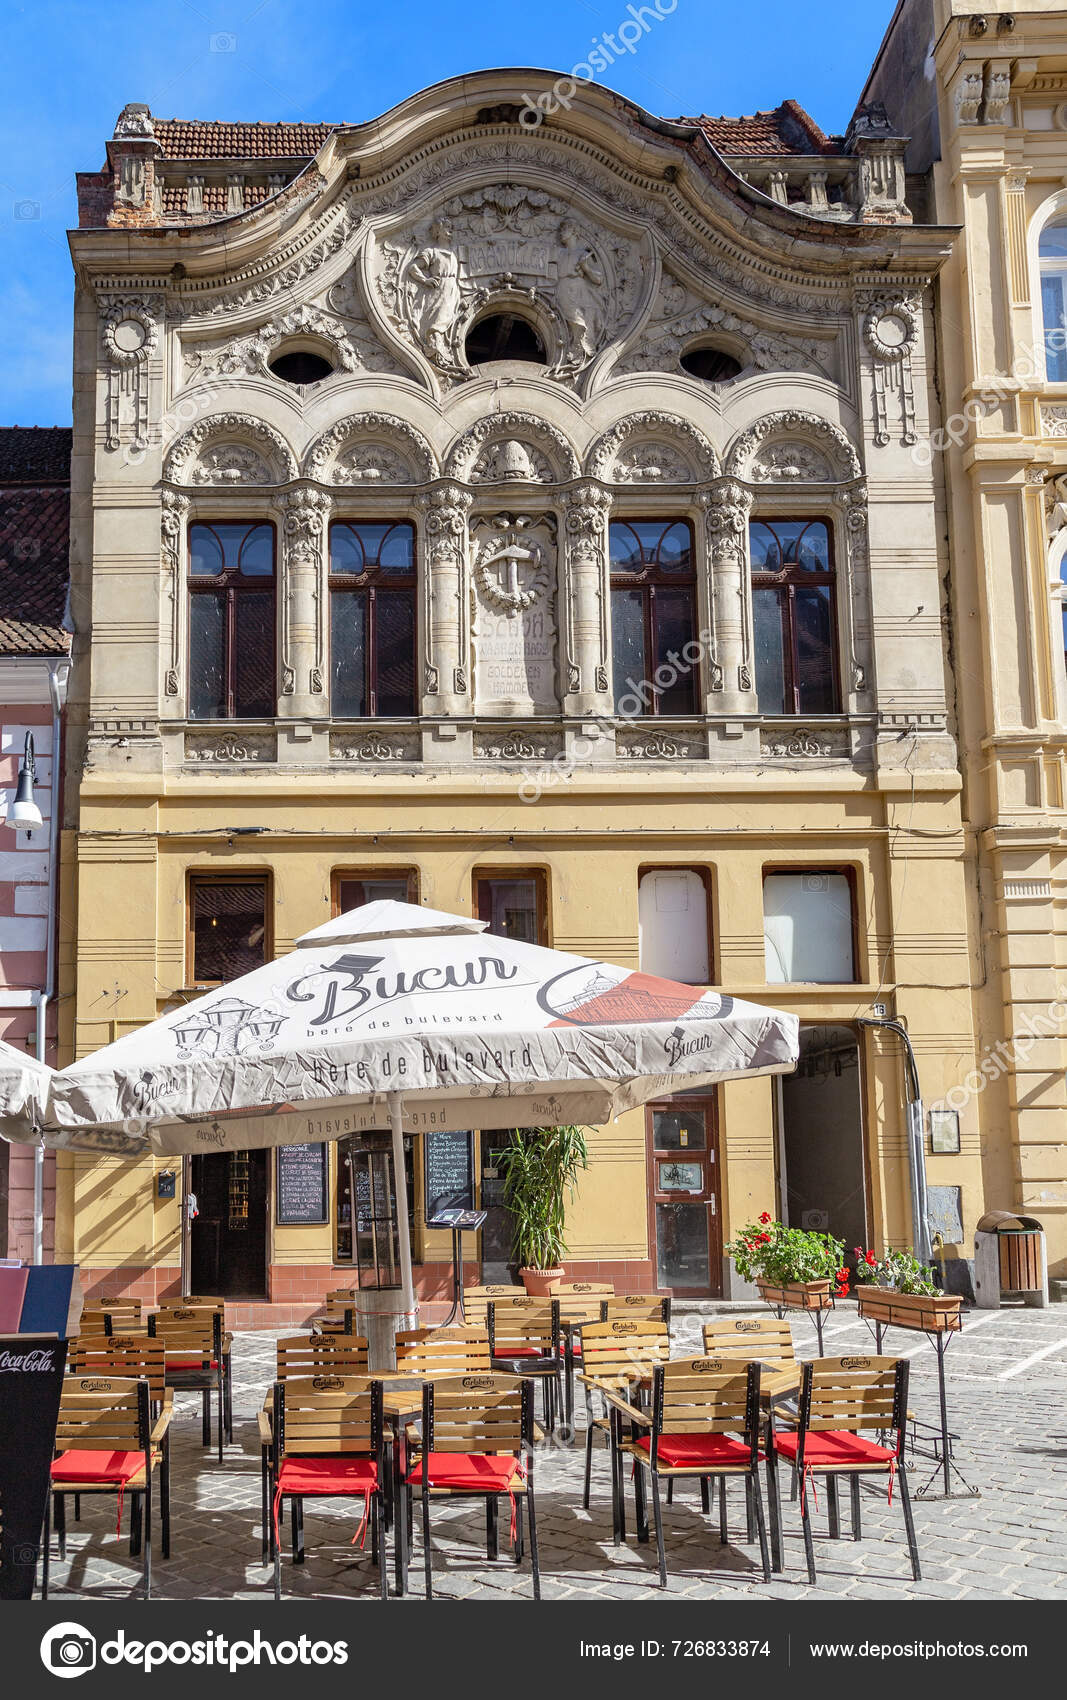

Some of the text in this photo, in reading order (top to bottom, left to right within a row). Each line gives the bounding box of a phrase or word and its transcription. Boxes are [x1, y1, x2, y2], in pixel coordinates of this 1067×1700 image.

[287, 957, 518, 1025] Bucur
[306, 1013, 503, 1037] bere de bulevard
[664, 1033, 712, 1067] Bucur
[313, 1043, 532, 1083] bere de bulevard
[134, 1077, 181, 1111] Bucur
[572, 1284, 592, 1292] Carlsberg
[512, 1298, 535, 1307] Carlsberg
[625, 1296, 646, 1305] Carlsberg
[612, 1321, 638, 1333] Carlsberg
[735, 1320, 761, 1332] Carlsberg
[108, 1337, 134, 1348] Carlsberg
[309, 1335, 336, 1347] Carlsberg
[691, 1359, 723, 1372] Carlsberg
[840, 1356, 872, 1369] Carlsberg
[80, 1379, 112, 1392] Carlsberg
[312, 1377, 345, 1390] Carlsberg
[462, 1376, 495, 1390] Carlsberg
